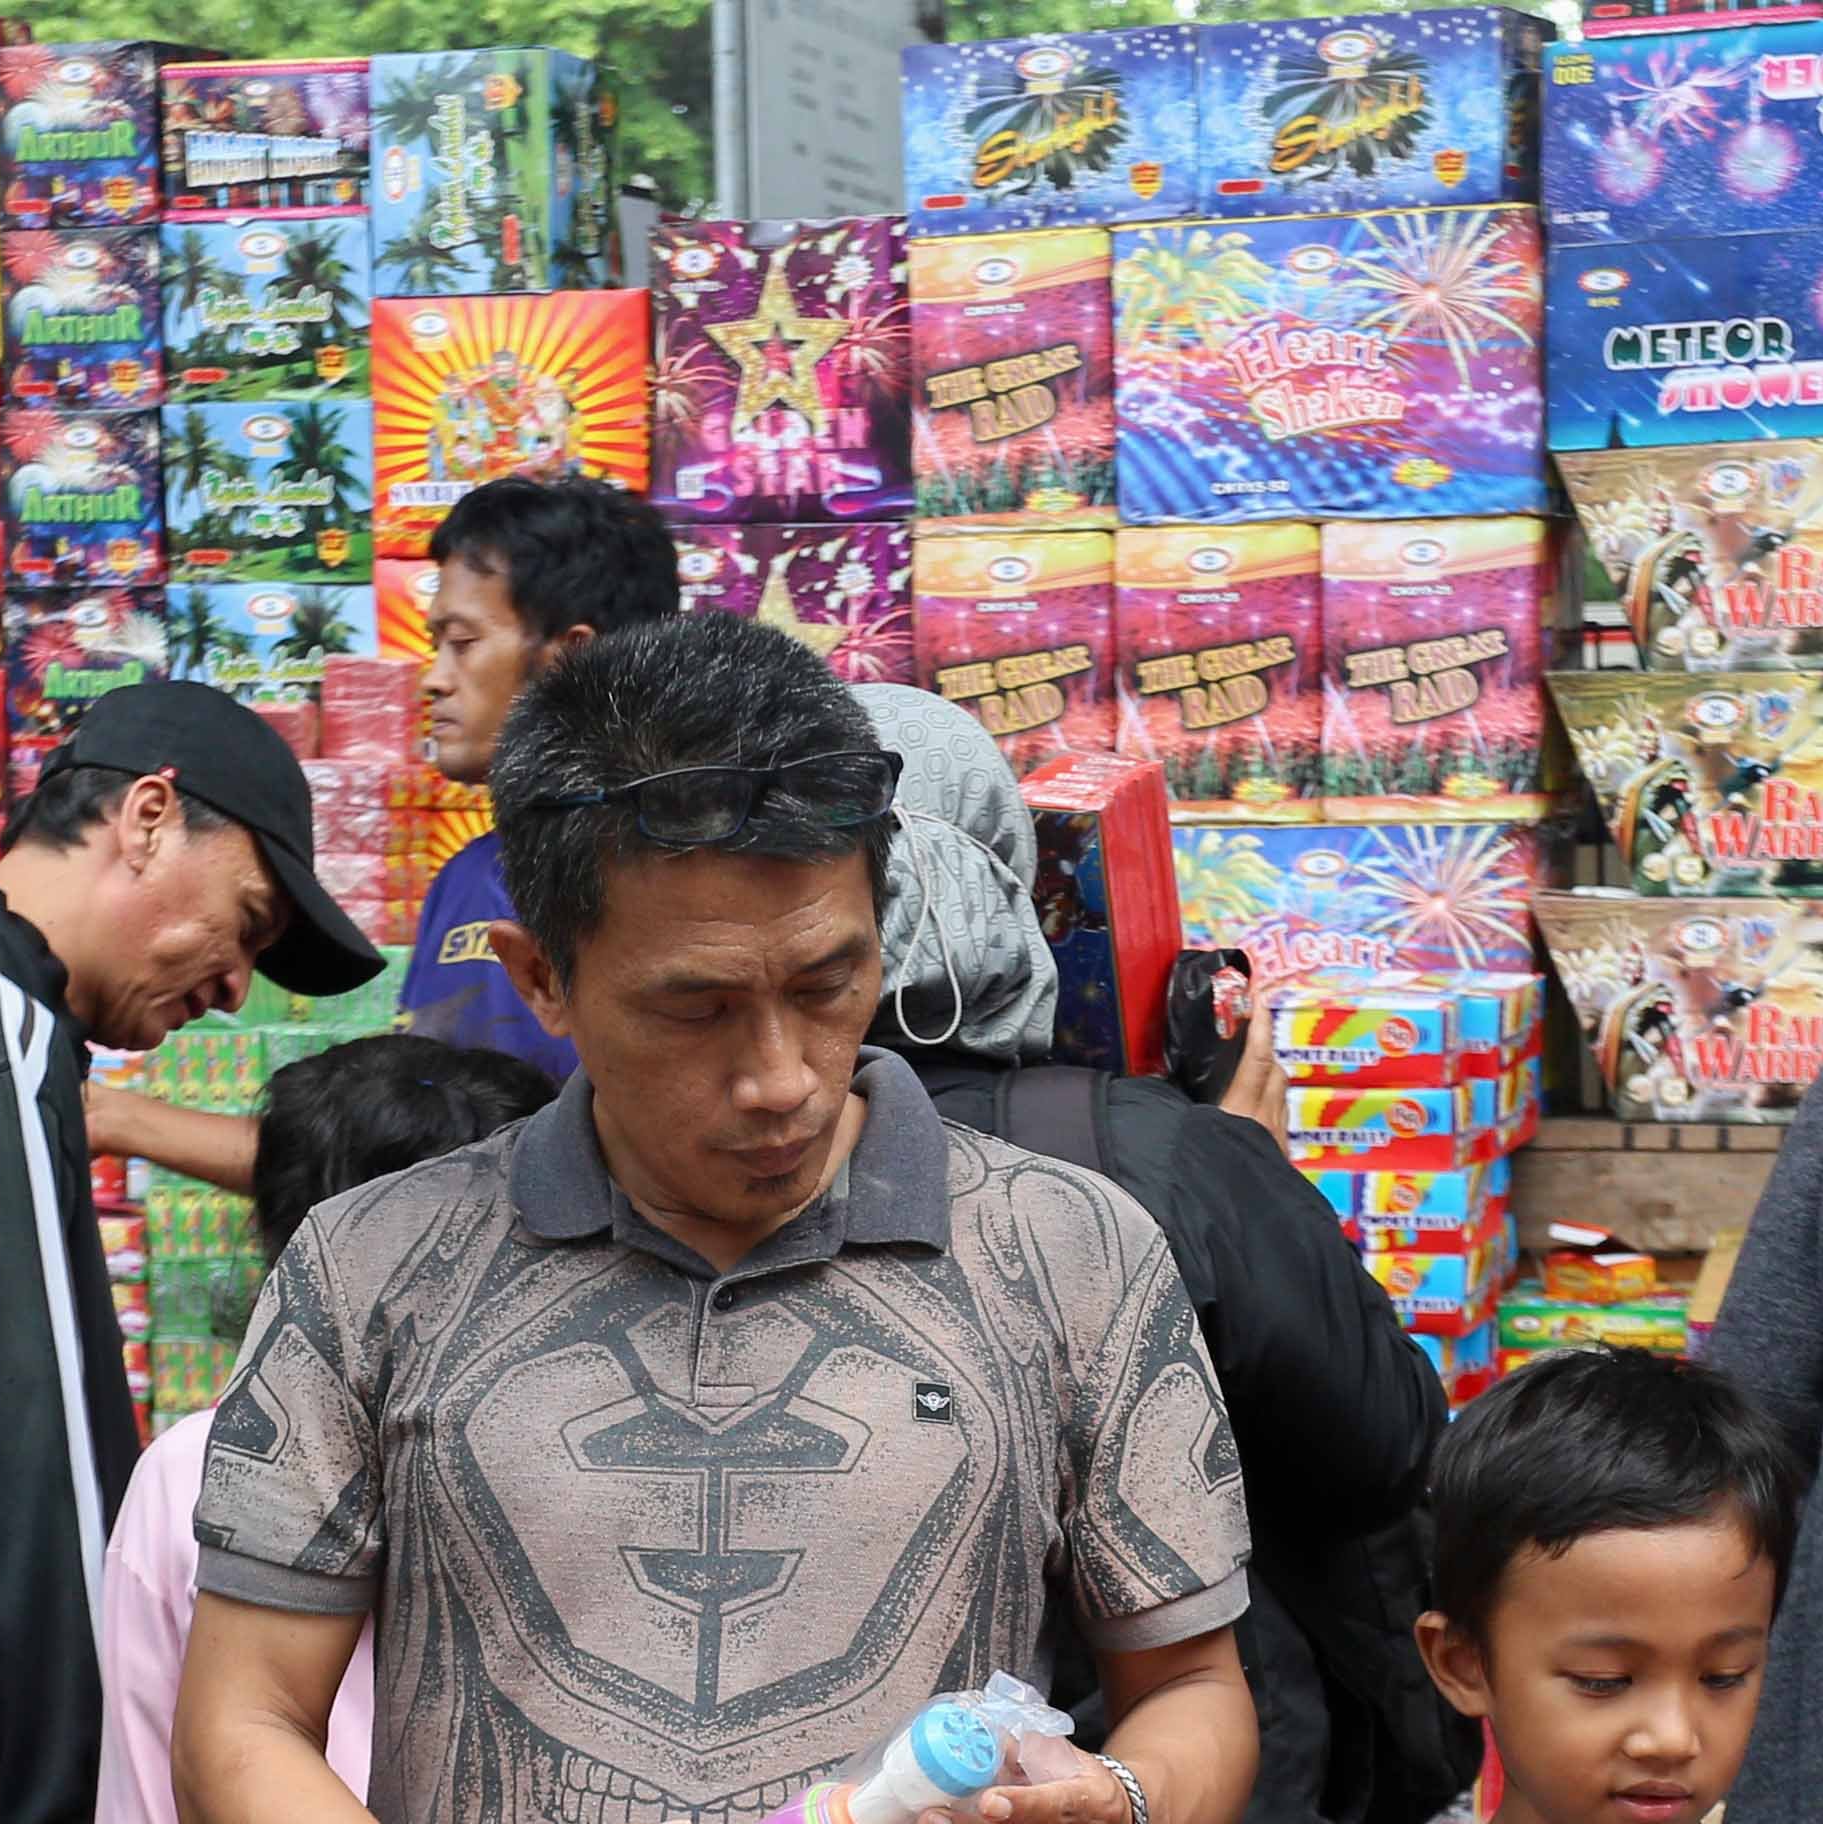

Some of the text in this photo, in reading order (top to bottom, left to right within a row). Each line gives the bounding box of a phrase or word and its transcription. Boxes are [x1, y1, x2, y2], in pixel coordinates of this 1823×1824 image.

[14, 119, 138, 163] ARTHUR
[19, 303, 145, 346] ARTHUR
[1603, 317, 1795, 371] METEOR
[1222, 322, 1390, 388] Heart
[928, 366, 987, 408] THE
[970, 384, 1056, 442] RAID
[19, 484, 146, 525] ARTHUR
[937, 663, 995, 702] THE
[1137, 652, 1196, 695] THE
[1346, 647, 1407, 687] THE
[980, 682, 1065, 735] RAID
[1181, 674, 1268, 729] RAID
[1391, 669, 1479, 724] RAID
[1249, 917, 1394, 980] Heart
